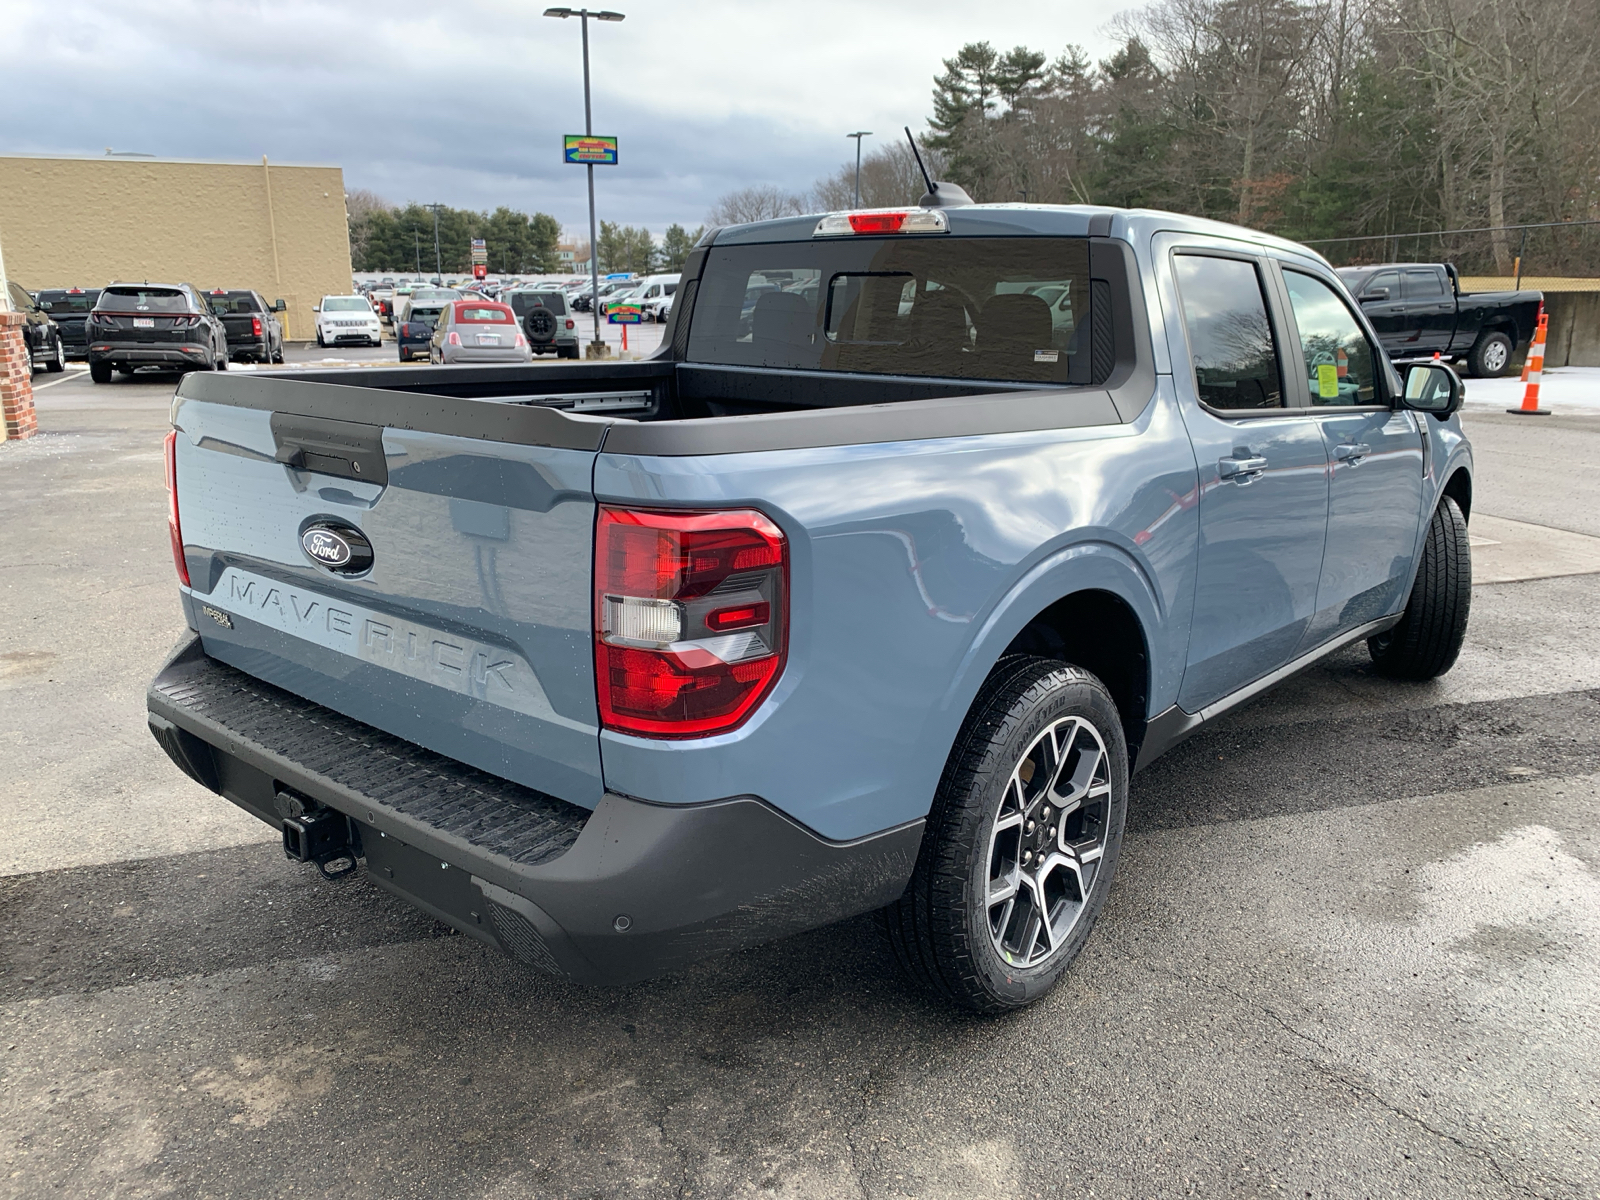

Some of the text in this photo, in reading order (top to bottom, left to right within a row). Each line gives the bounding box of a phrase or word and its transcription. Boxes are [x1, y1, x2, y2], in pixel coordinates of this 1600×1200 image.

[311, 534, 340, 560] Ford
[231, 575, 514, 693] MAVERICK
[1011, 696, 1066, 762] GOODYEAR
